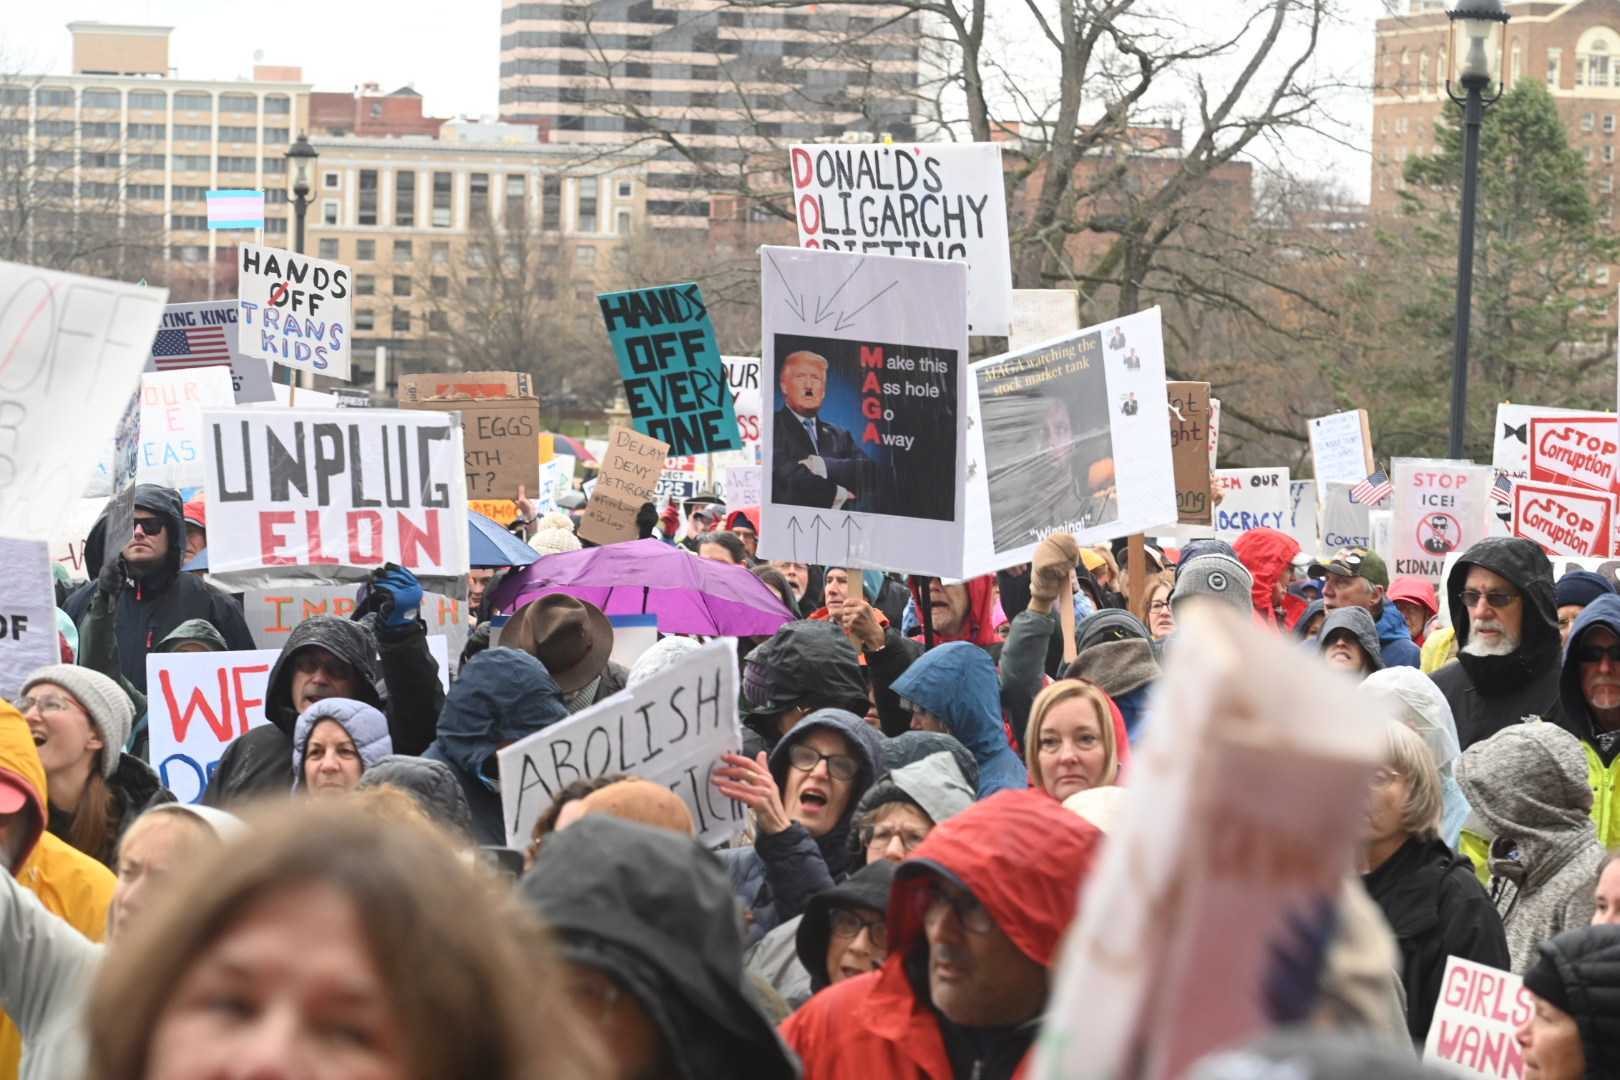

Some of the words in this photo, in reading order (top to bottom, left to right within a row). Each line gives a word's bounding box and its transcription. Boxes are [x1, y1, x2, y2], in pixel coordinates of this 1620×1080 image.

[799, 192, 988, 239] OLIGARCHY
[243, 248, 347, 299] HANDS
[268, 281, 324, 317] OFF
[600, 284, 707, 332] HANDS
[241, 302, 343, 351] TRANS
[261, 329, 328, 370] KIDS
[625, 329, 704, 374] OFF
[919, 356, 948, 373] this
[1025, 345, 1077, 368] watching
[1078, 338, 1097, 354] the
[624, 365, 727, 419] EVERY
[905, 381, 940, 398] hole
[993, 375, 1024, 396] stock
[1024, 365, 1063, 386] market
[1064, 356, 1091, 374] tank
[477, 415, 533, 441] EGGS
[616, 431, 666, 459] DELAY
[646, 410, 732, 458] ONE
[1556, 427, 1617, 455] STOP
[213, 420, 451, 508] UNPLUG
[614, 455, 653, 480] DENY
[1539, 428, 1612, 480] Corruption
[1250, 474, 1280, 488] OUR
[1413, 472, 1468, 489] STOP
[1215, 511, 1283, 531] OCRACY
[1422, 494, 1455, 508] ICE!
[1538, 498, 1594, 533] STOP
[259, 509, 442, 568] ELON
[1522, 499, 1589, 556] Corruption
[513, 666, 721, 836] ABOLISH
[1444, 965, 1537, 1026] GIRLS
